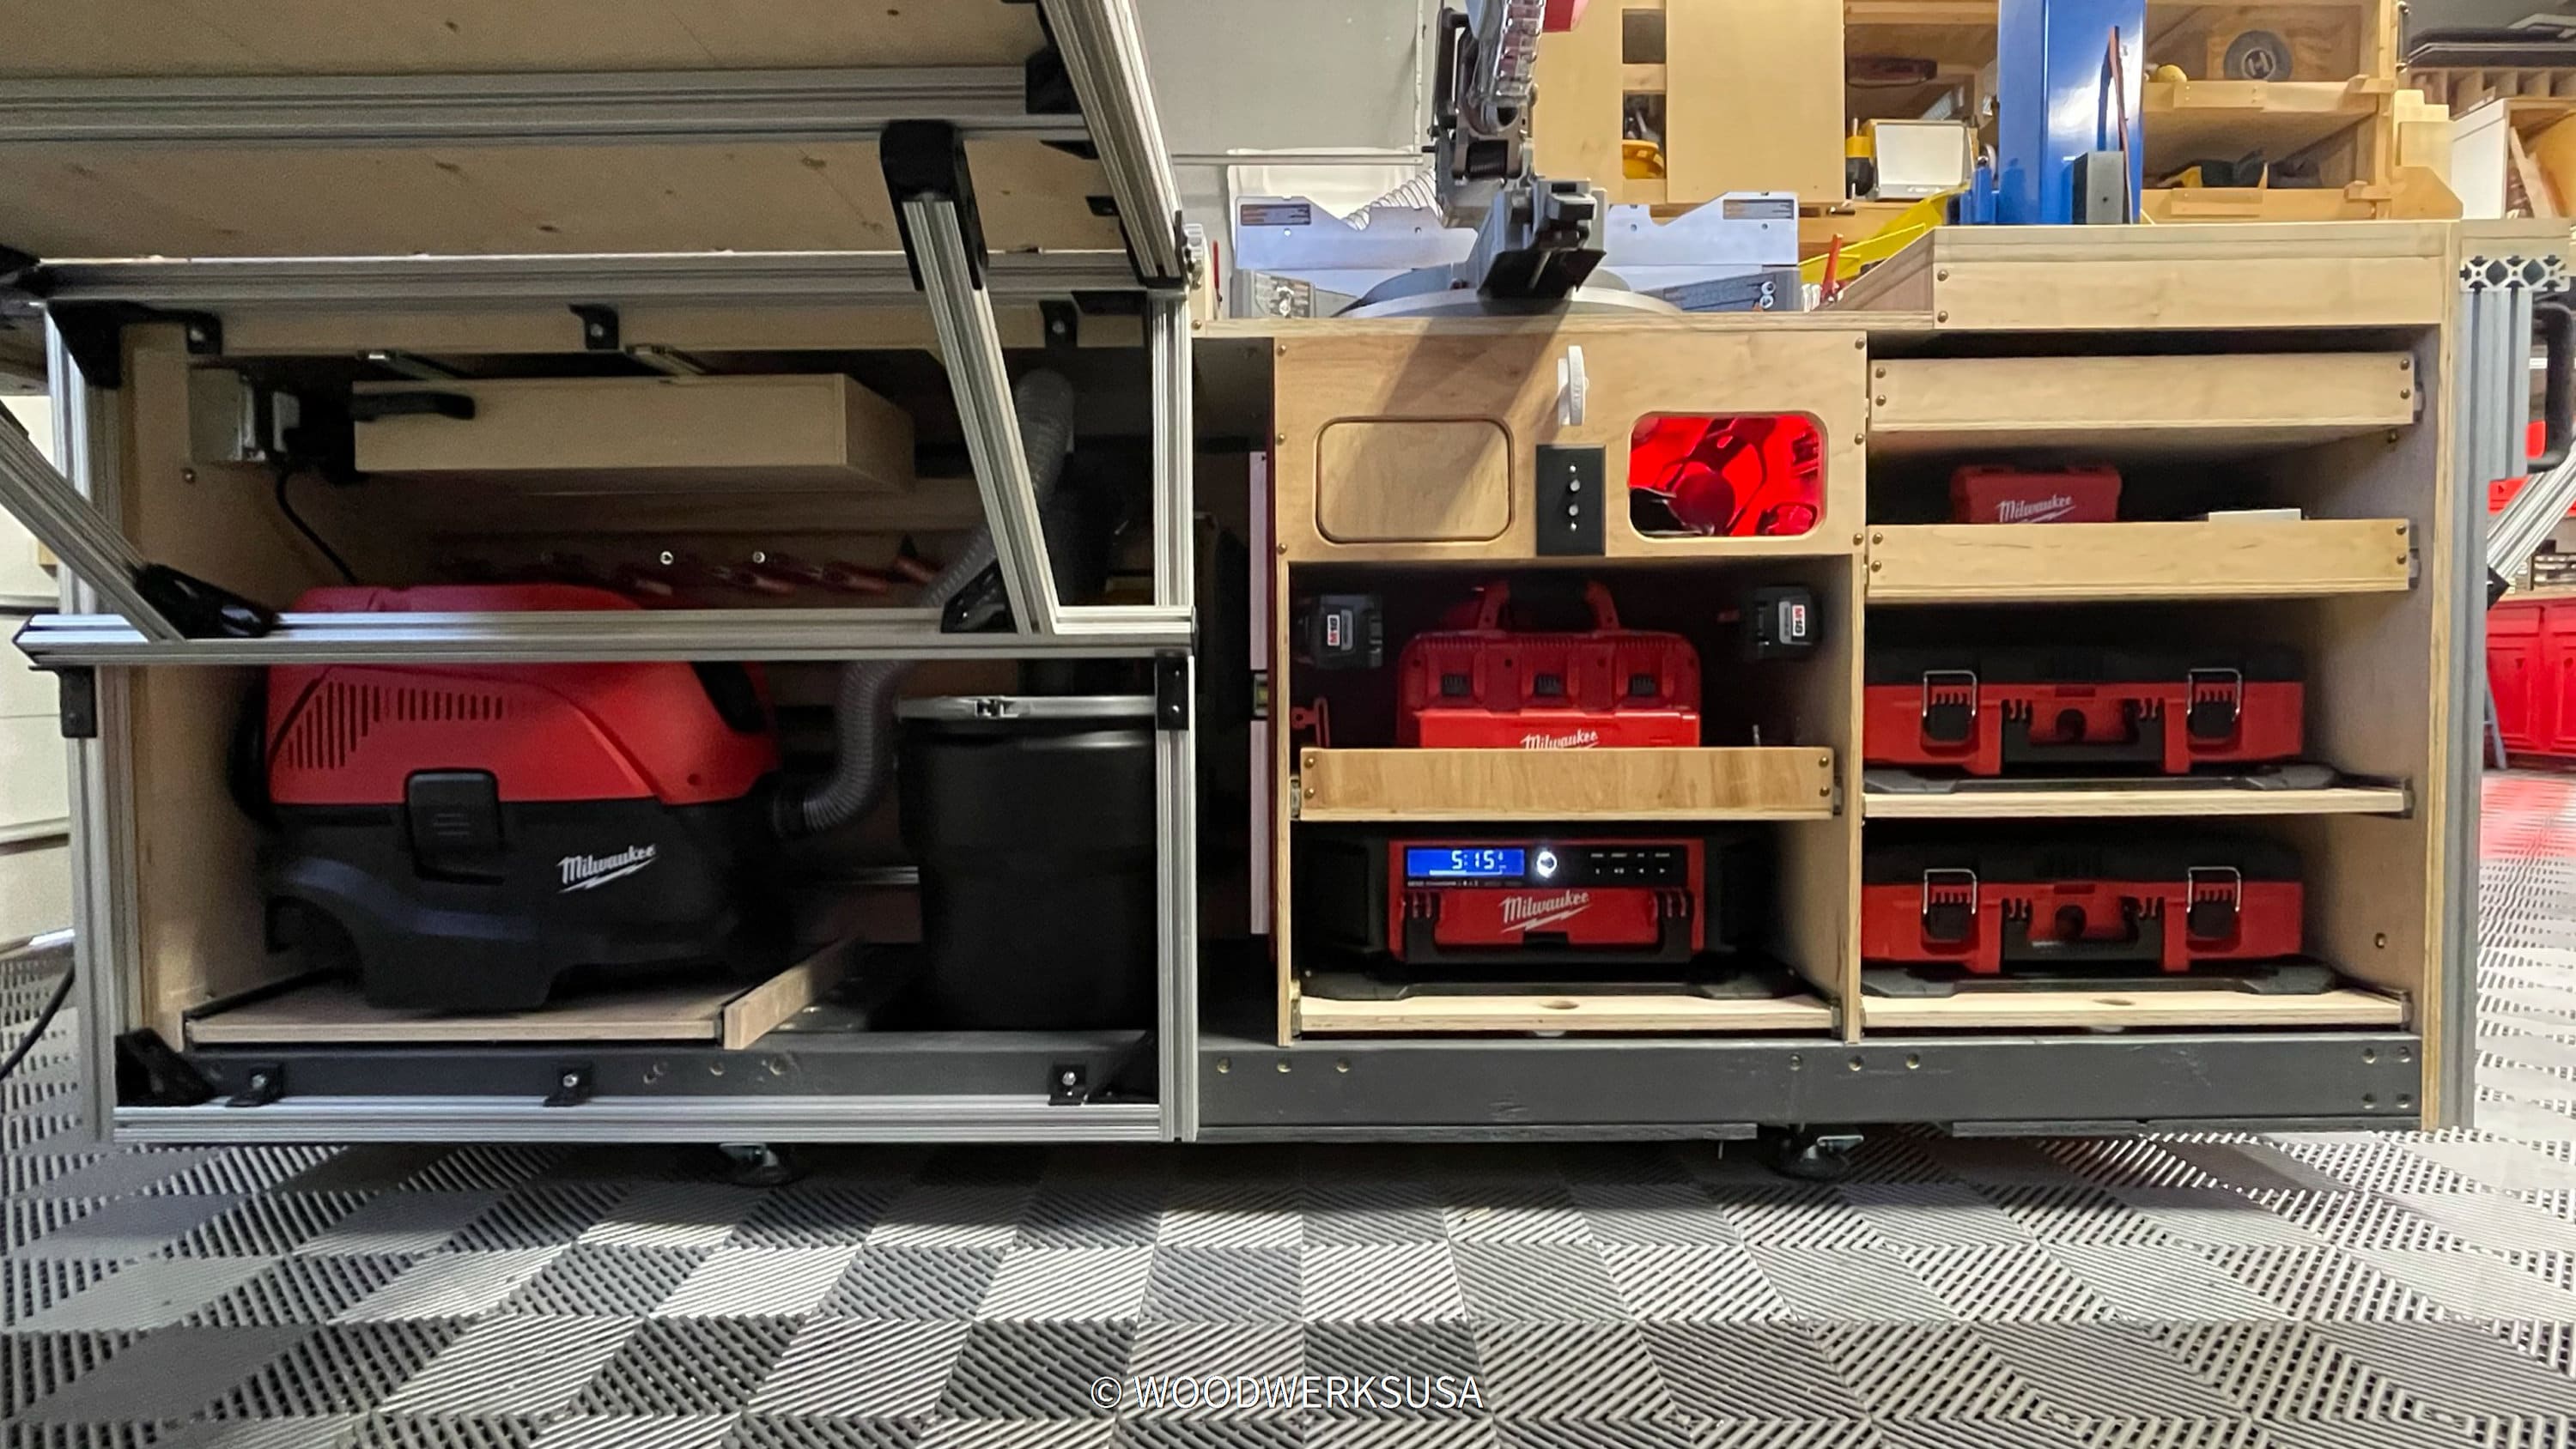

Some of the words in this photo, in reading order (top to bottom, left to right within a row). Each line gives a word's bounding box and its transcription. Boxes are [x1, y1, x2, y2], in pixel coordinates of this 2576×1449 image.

[1995, 494, 2072, 523] Milwaukee
[1520, 729, 1598, 749] Milwaukee
[556, 845, 656, 885] Milwaukee
[1451, 850, 1494, 870] 5:15
[1498, 889, 1589, 924] Milwaukee
